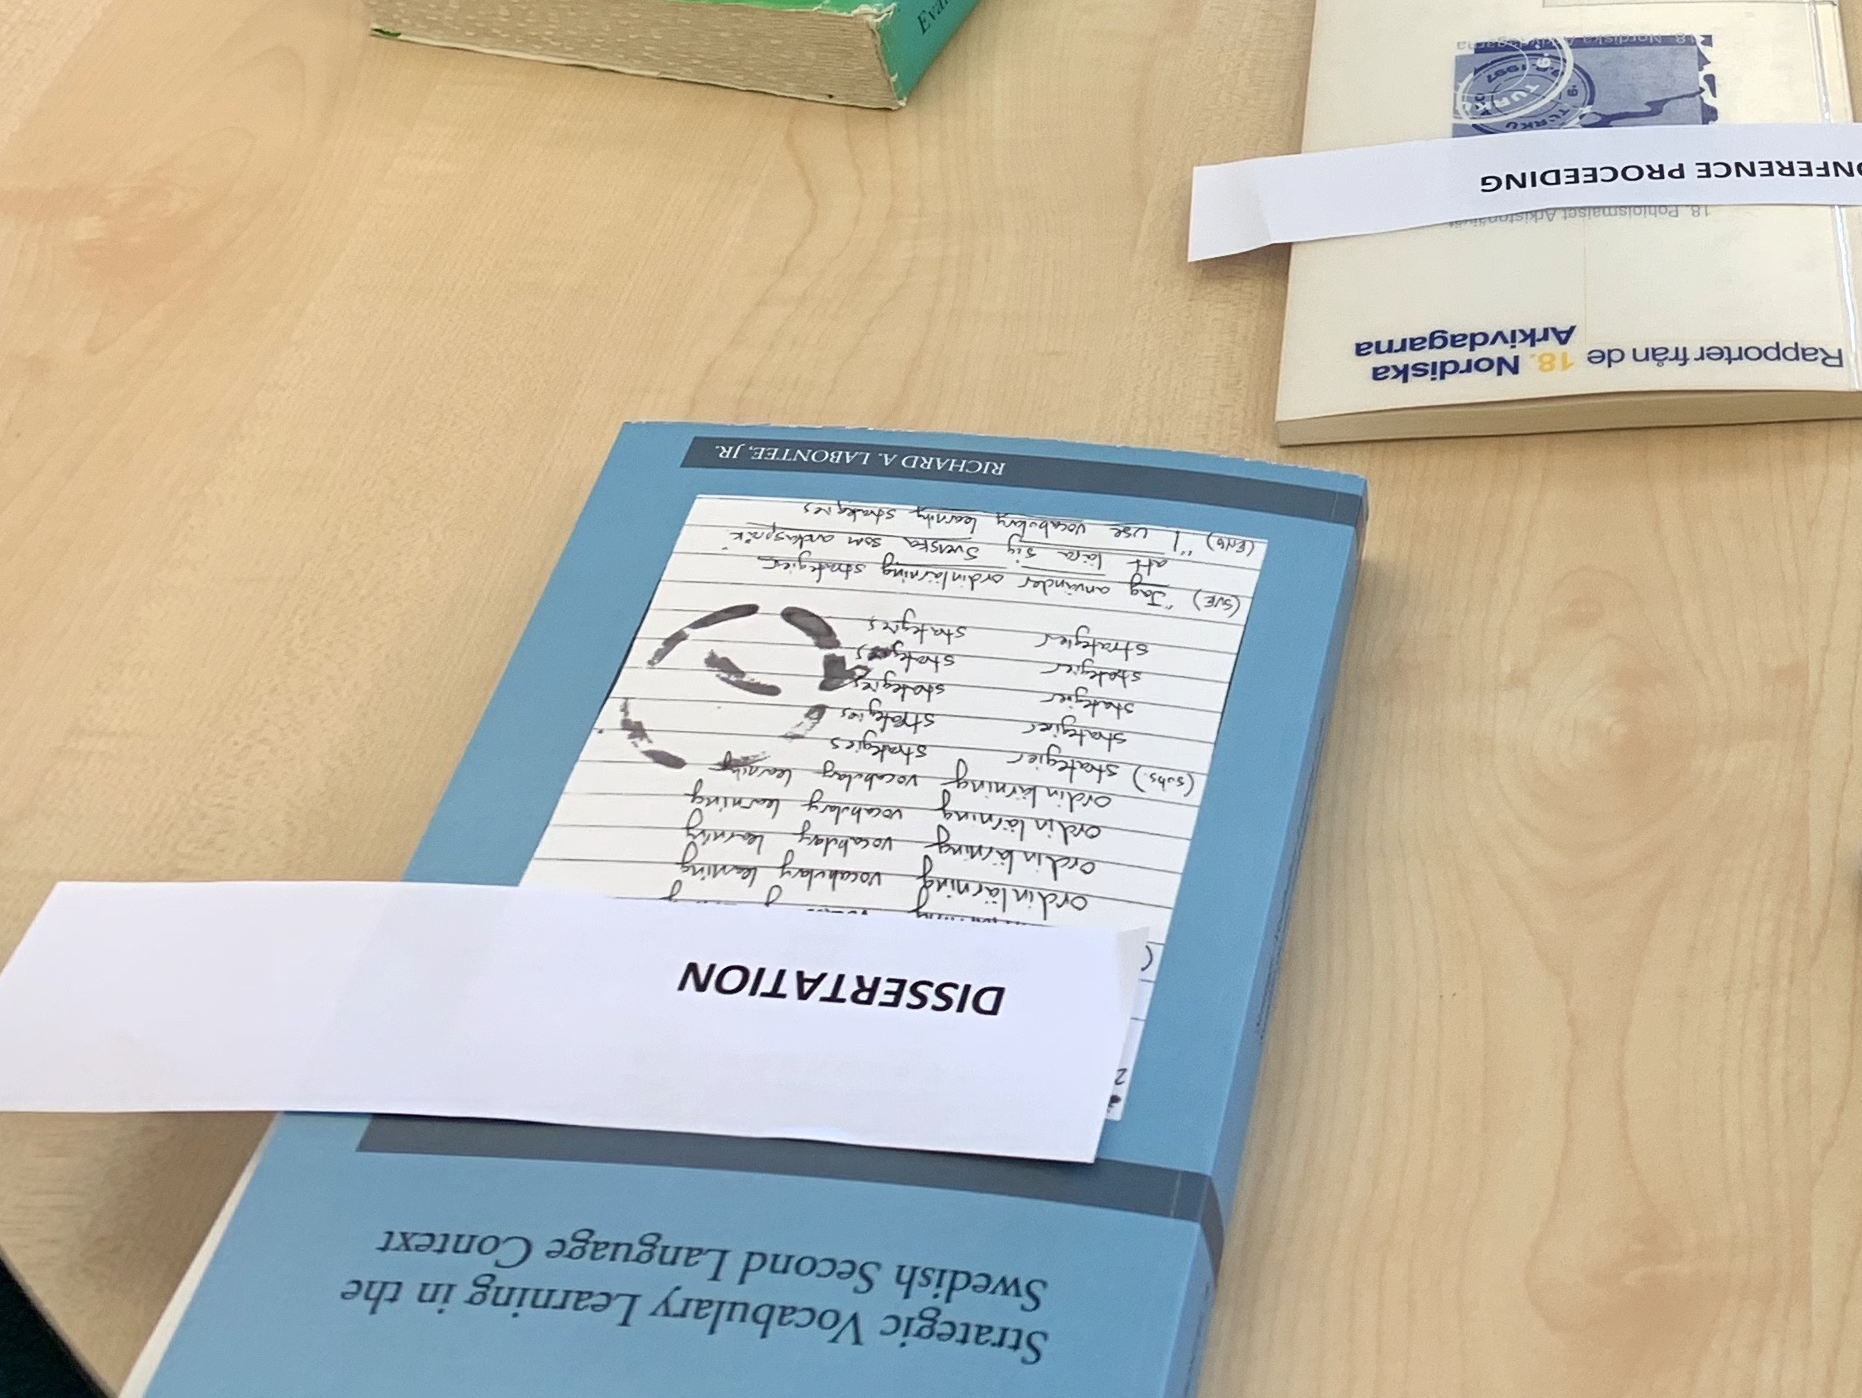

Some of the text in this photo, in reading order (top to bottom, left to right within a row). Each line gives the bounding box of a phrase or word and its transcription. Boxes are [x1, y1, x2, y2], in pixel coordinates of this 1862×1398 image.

[1479, 162, 1685, 194] PROCEEDING
[1354, 325, 1576, 358] Arkivdagarna
[1371, 342, 1844, 383] Rapporter från de 18. Nordiska
[714, 442, 1007, 476] RICHARD A. LABONTEE, JR.
[848, 534, 882, 548] som
[762, 550, 862, 583] strategier
[881, 552, 1004, 590] ordinlärning
[1058, 549, 1101, 570] lära
[1017, 575, 1110, 597] använder
[1035, 626, 1149, 657] strategier
[1040, 686, 1134, 715] strategier
[828, 731, 927, 761] strategies
[1020, 717, 1128, 750] strategier
[1005, 745, 1121, 782] strategier
[677, 960, 1006, 1017] DISSERTATION
[374, 1228, 1049, 1314] Swedish Second Language Context
[339, 1275, 1049, 1366] Strategic Vocabulary Learning in the
